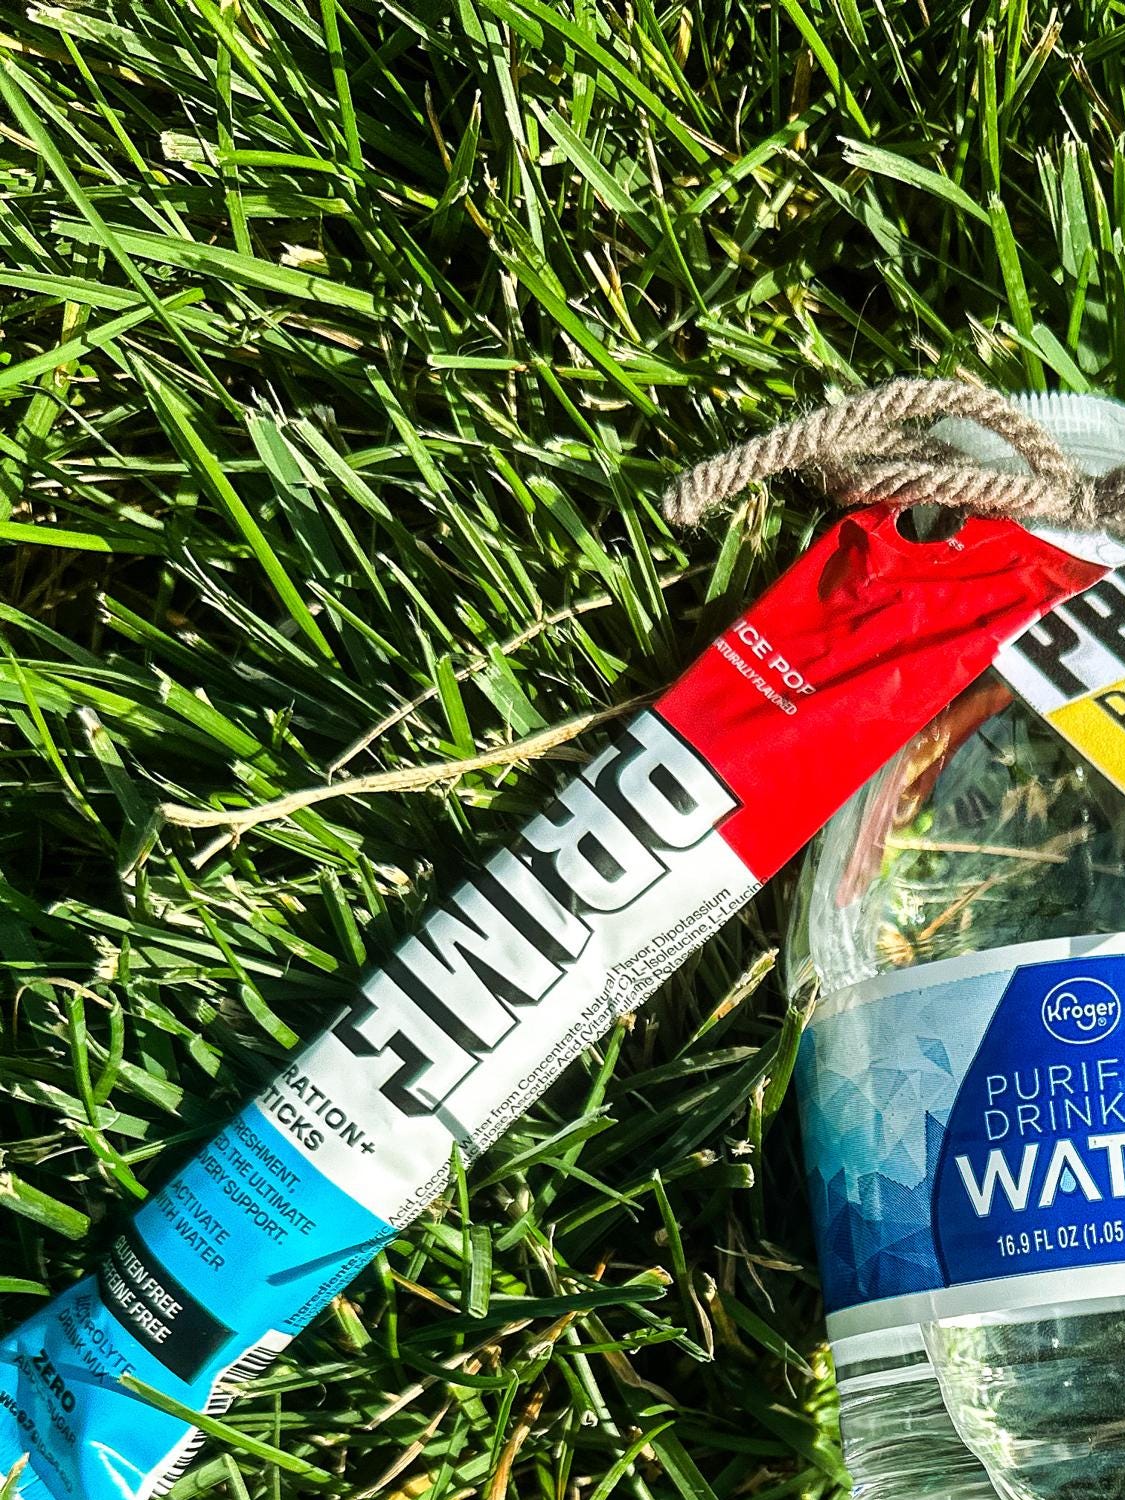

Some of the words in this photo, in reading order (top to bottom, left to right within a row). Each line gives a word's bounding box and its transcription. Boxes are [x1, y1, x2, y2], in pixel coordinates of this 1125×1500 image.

[733, 620, 773, 660] ICE
[768, 656, 816, 696] POP
[752, 672, 797, 716] FLAVORED
[329, 710, 744, 1118] PRIME
[509, 1063, 557, 1113] Ascorbic
[556, 1038, 583, 1064] Acid
[582, 986, 625, 1043] (Vitamin
[632, 921, 712, 977] L-Isoleucine,
[259, 1085, 325, 1151] TICKS
[282, 1064, 376, 1155] RATION+
[283, 1252, 362, 1325] Ingredients:
[388, 1197, 416, 1225] Acid,
[415, 1153, 459, 1196] Cocon
[459, 1117, 497, 1151] Water
[490, 1091, 520, 1119] from
[518, 1022, 587, 1090] Concentrate,
[581, 972, 616, 1021] Natural
[612, 944, 657, 975] Flavor,
[651, 888, 732, 948] Dipotassium
[169, 1178, 230, 1247] ACTIVATE
[223, 1181, 289, 1246] SUPPORT.
[226, 1146, 254, 1179] THE
[248, 1170, 317, 1236] ULTIMATE
[173, 1215, 227, 1273] WATER
[997, 1233, 1030, 1257] 16.9
[1035, 1230, 1054, 1251] FL
[1057, 1226, 1079, 1249] OZ
[1083, 1221, 1124, 1250] (1.05
[101, 1254, 138, 1309] FFEINE
[128, 1299, 173, 1345] FREE
[112, 1235, 149, 1284] GLUTEN
[142, 1279, 184, 1321] FREE
[31, 1349, 77, 1413] ZERO
[57, 1307, 88, 1356] DRINK
[82, 1349, 111, 1384] MIX
